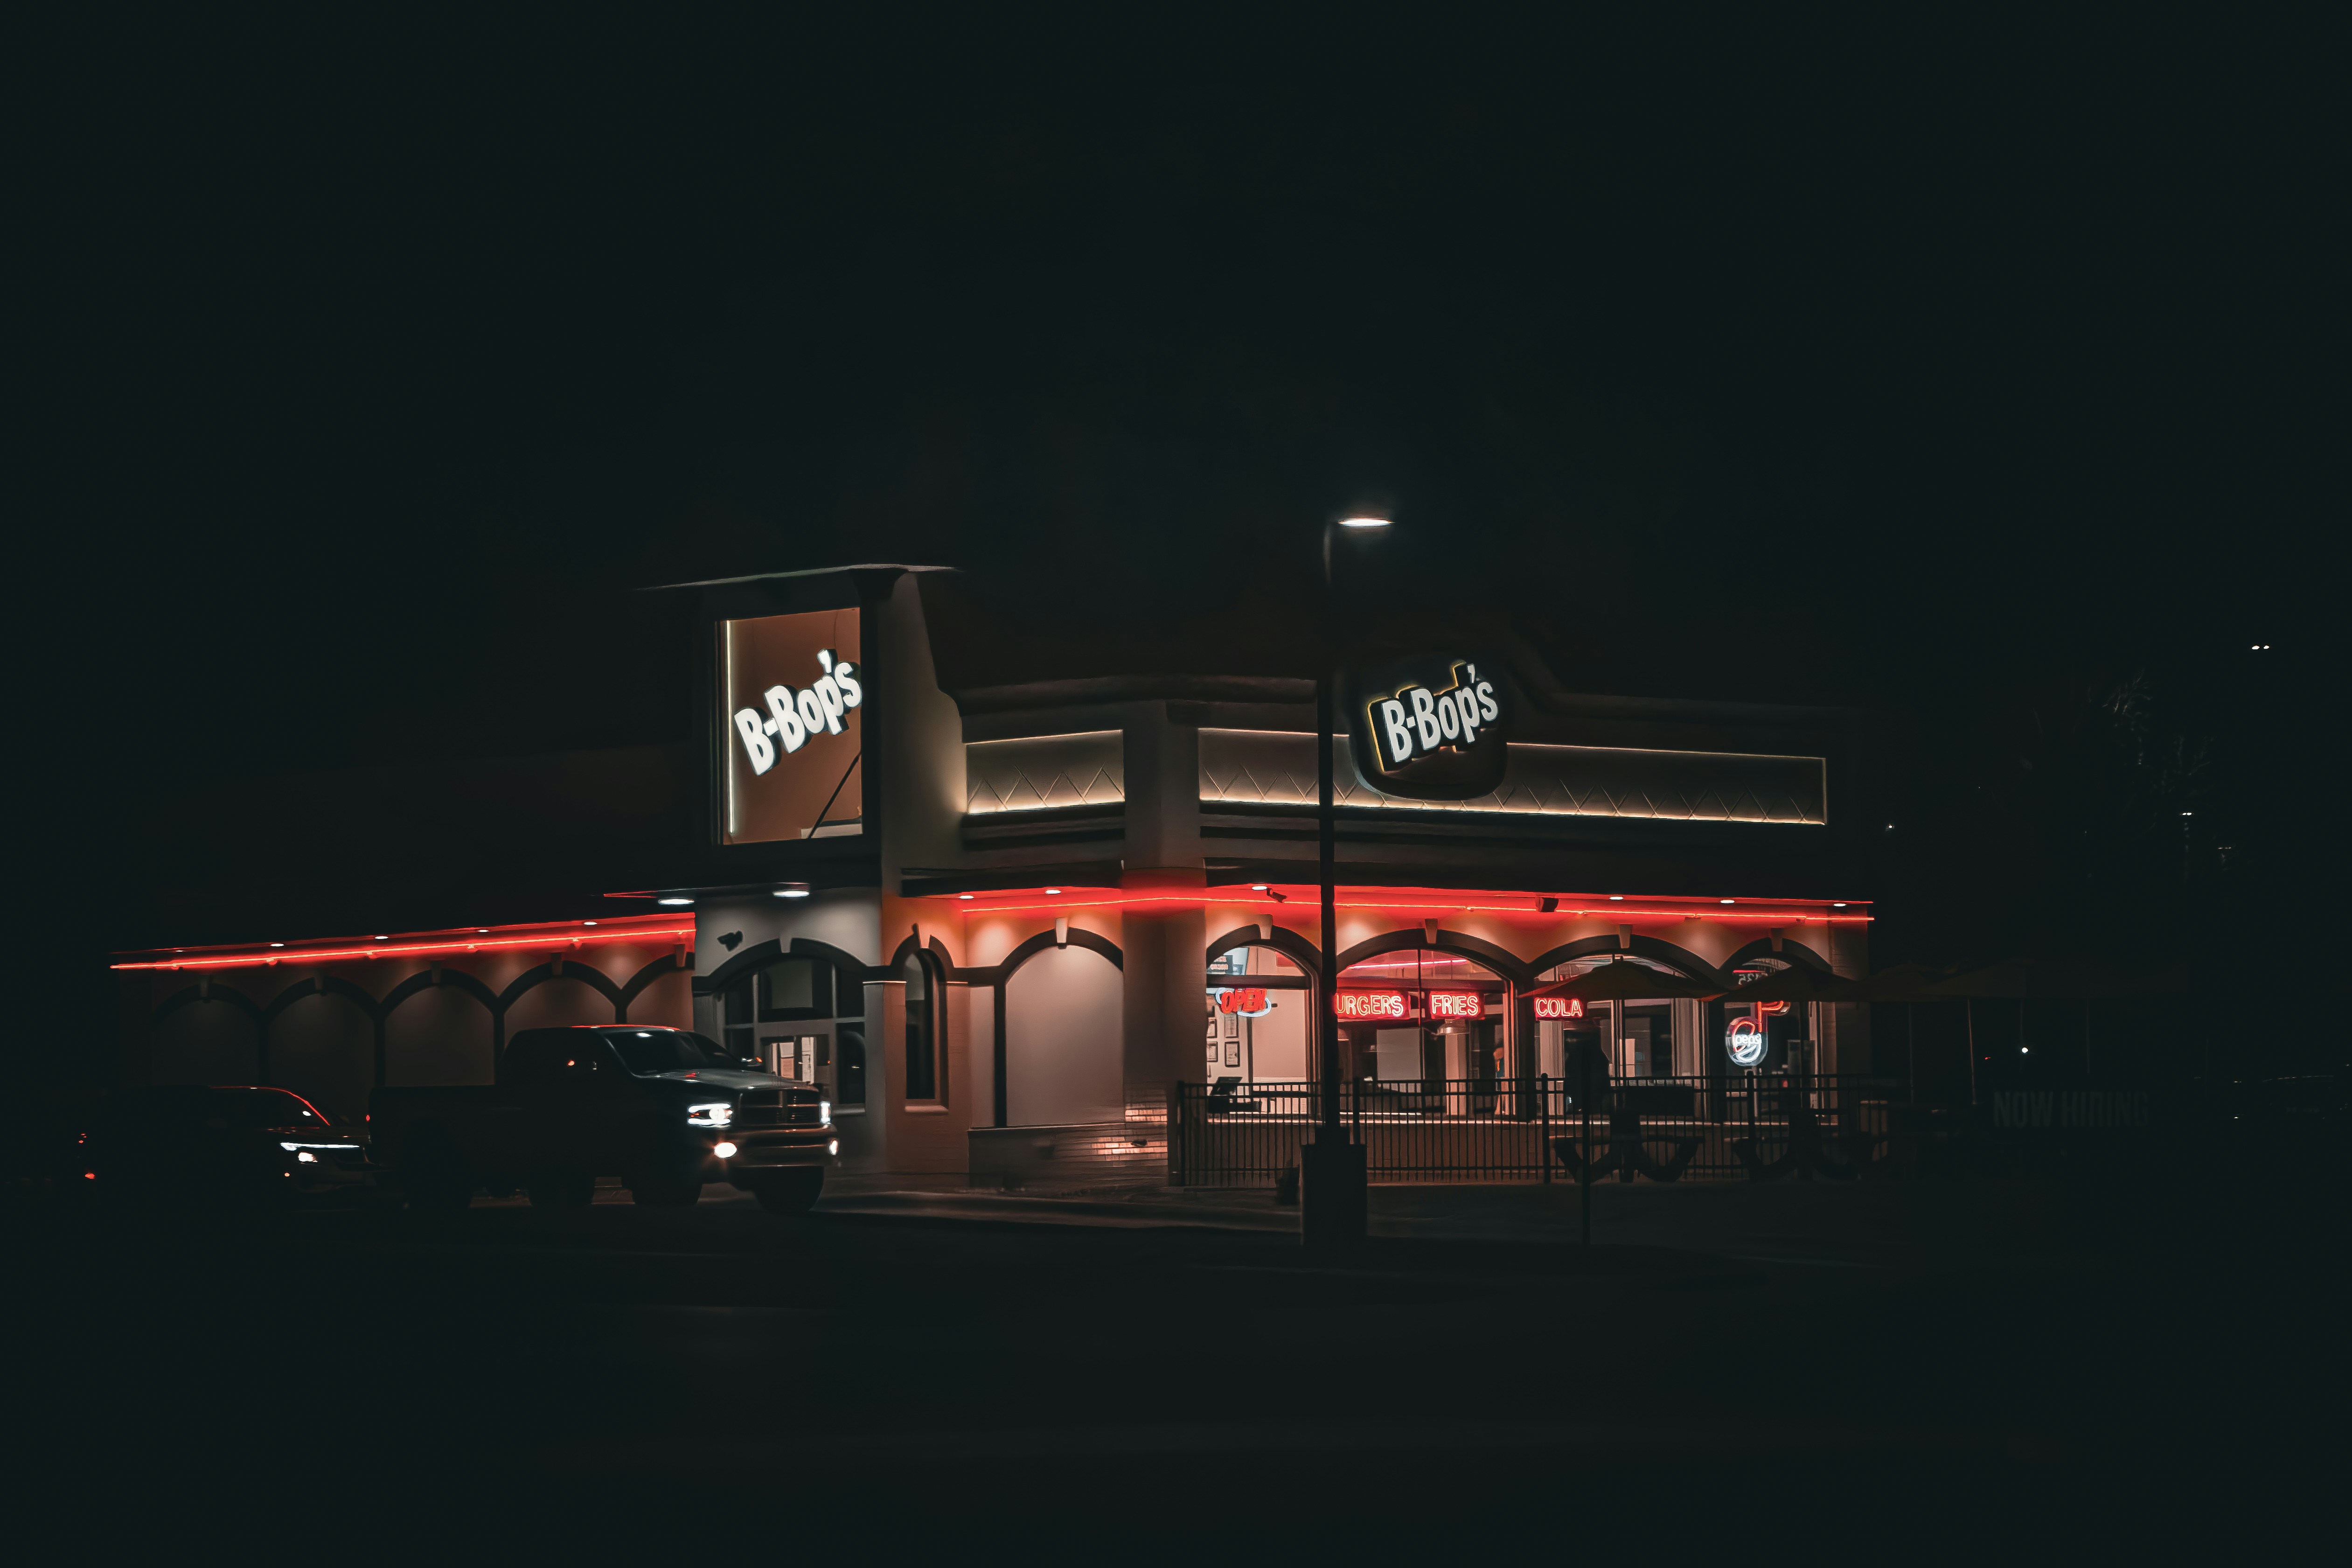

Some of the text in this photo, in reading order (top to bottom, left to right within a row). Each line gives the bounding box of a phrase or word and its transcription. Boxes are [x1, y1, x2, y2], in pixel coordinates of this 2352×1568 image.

[734, 649, 862, 776] B-Bop's
[1382, 663, 1498, 763] B-Bop's
[1221, 988, 1267, 1014] OPEN
[1336, 994, 1404, 1017] URGERS
[1431, 995, 1479, 1016] FRIES
[1536, 998, 1582, 1017] COLA
[1993, 1090, 2149, 1128] NOW HIRING
